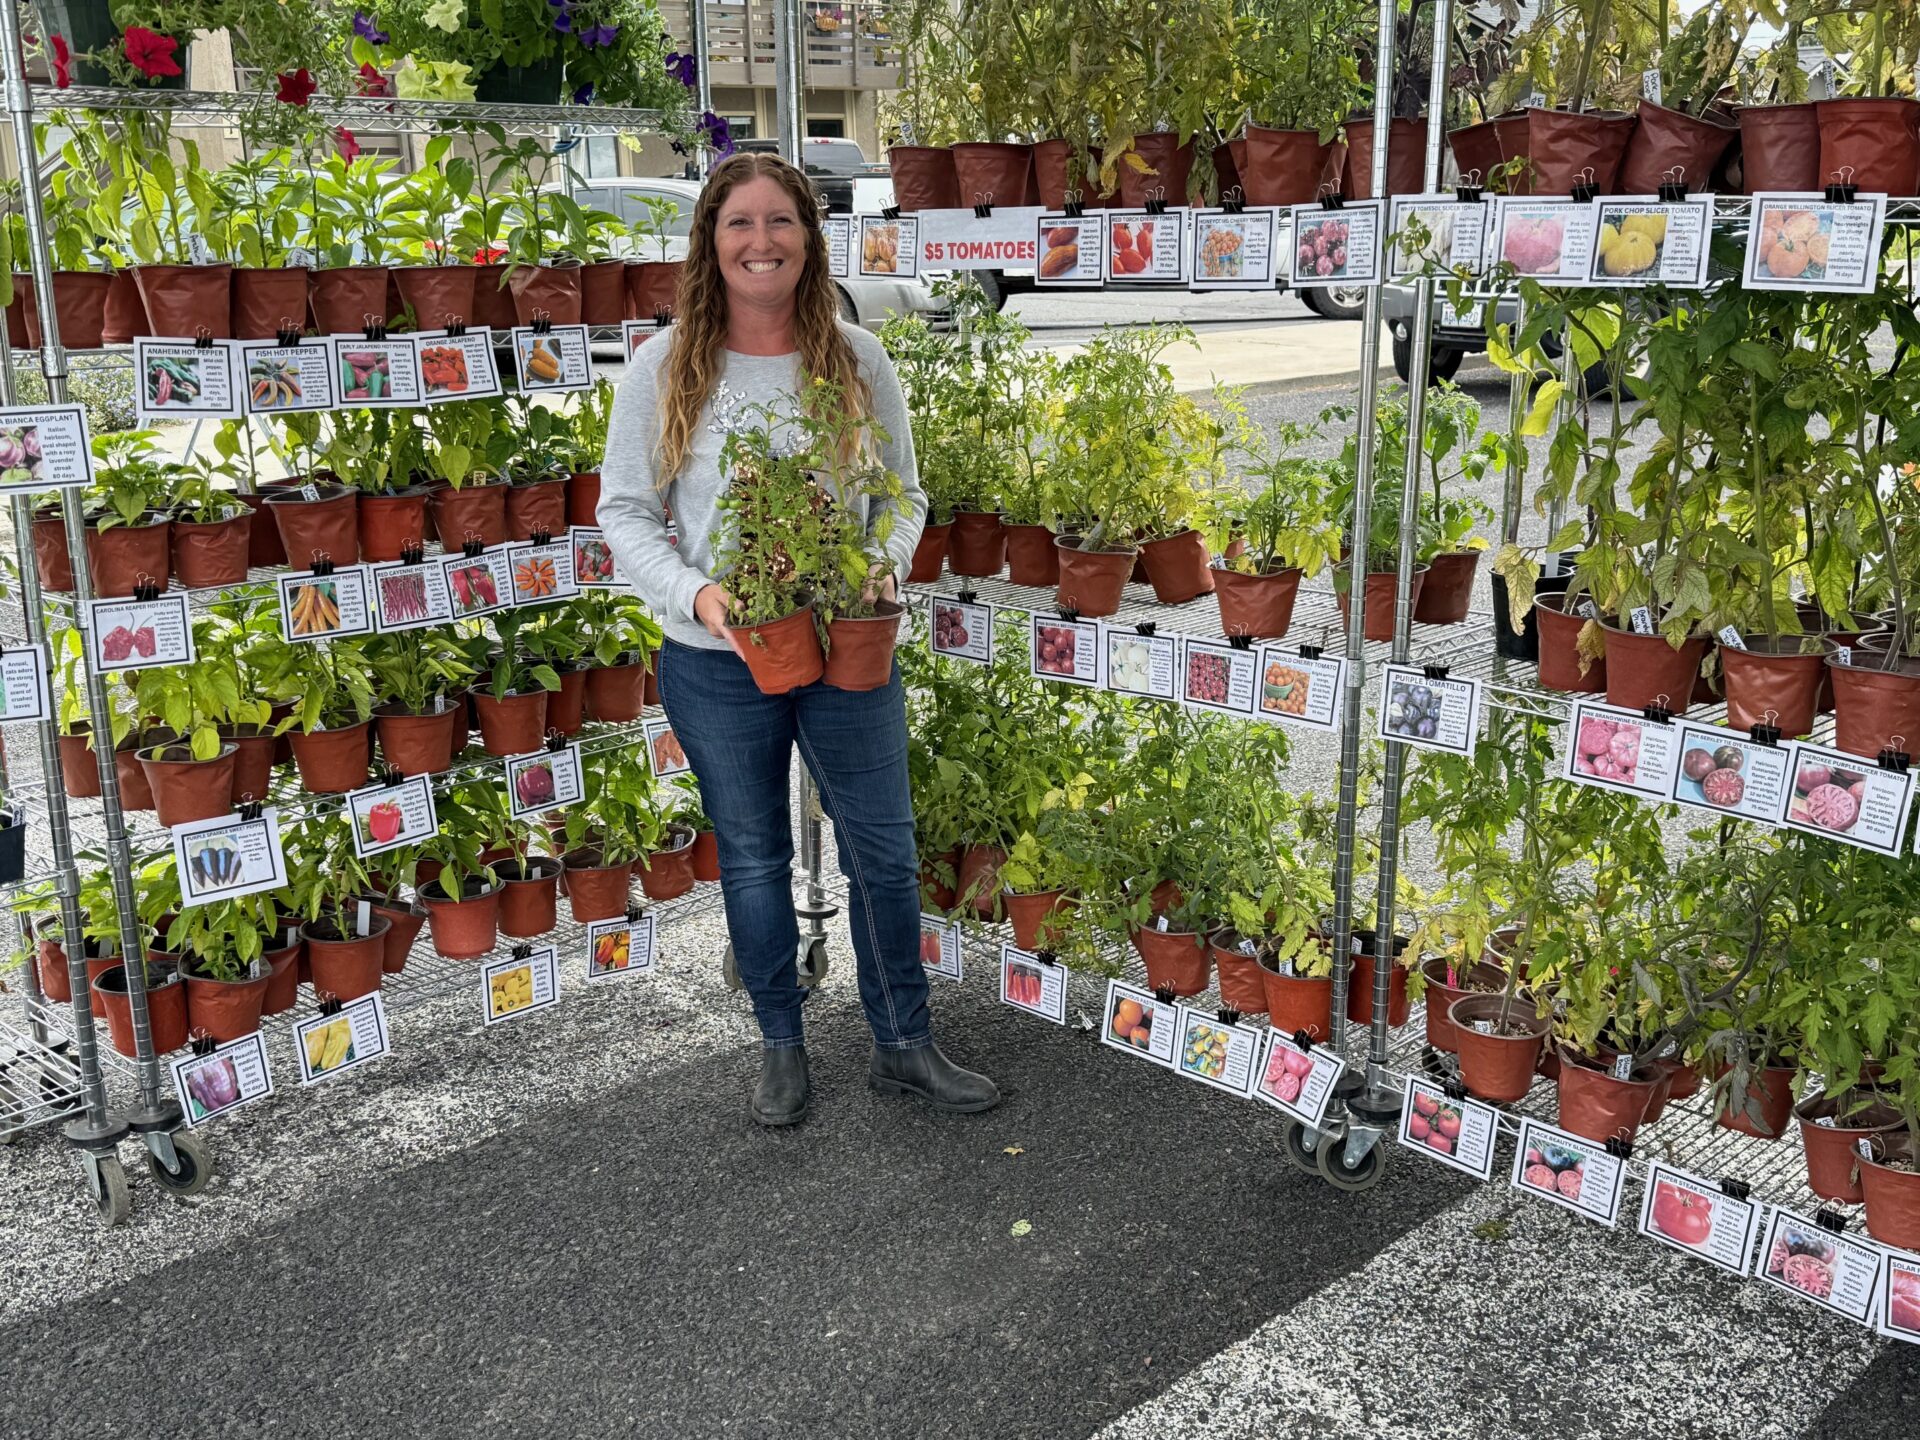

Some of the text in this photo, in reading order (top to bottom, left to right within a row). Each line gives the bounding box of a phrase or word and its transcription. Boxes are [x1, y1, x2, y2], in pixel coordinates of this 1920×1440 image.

[925, 242, 943, 261] $5
[947, 241, 1035, 260] TOMATOES
[291, 348, 318, 356] PEPPER
[35, 415, 73, 423] EGGPLANT
[514, 549, 531, 557] DATIL
[546, 544, 568, 552] PEPPER
[448, 556, 486, 570] PAPRIKA HOT
[389, 568, 414, 576] CAYENNE
[307, 577, 329, 585] CAYENNE
[96, 606, 123, 614] CAROLINA
[1268, 654, 1336, 670] SUNGOLD CHERRY TOMATO
[1396, 675, 1465, 692] PURPLE TOMATILLO
[1595, 713, 1630, 724] BRANDYWINE
[1632, 719, 1650, 728] SLICER
[1652, 722, 1675, 732] TOMATO
[1687, 732, 1699, 740] PINK
[1724, 739, 1732, 747] TIE
[1733, 741, 1742, 749] DYE
[1744, 743, 1761, 752] SLICER
[1763, 747, 1784, 757] TOMATO
[538, 755, 550, 763] SWEET
[552, 752, 567, 760] PEPPER
[1800, 753, 1905, 782] CHEROKEE PURPLE SLICER TOMATO
[395, 784, 408, 792] SWEET
[187, 823, 264, 841] PURPLE SPARKLE SWEET PEPPER
[629, 920, 647, 928] PEPPER
[490, 954, 548, 975] YELLOW BELL SWEET PEPPER
[1116, 990, 1175, 1014] VIVACIOUS PASTE TOMATO
[302, 1002, 372, 1032] YELLOW MONSTER SWEET PEPPER
[183, 1041, 254, 1072] PURPLE BELL SWEET PEPPER
[1416, 1086, 1489, 1118] EARLY GIRL SLICER TOMATO
[1530, 1130, 1619, 1165] BLACK BEAUTY SLICER TOMATO
[1658, 1172, 1748, 1211] SUPER STEAK SLICER TOMATO
[1780, 1217, 1876, 1262] BLACK KRIM SLICER TOMATO
[1893, 1262, 1915, 1272] SOLAR
